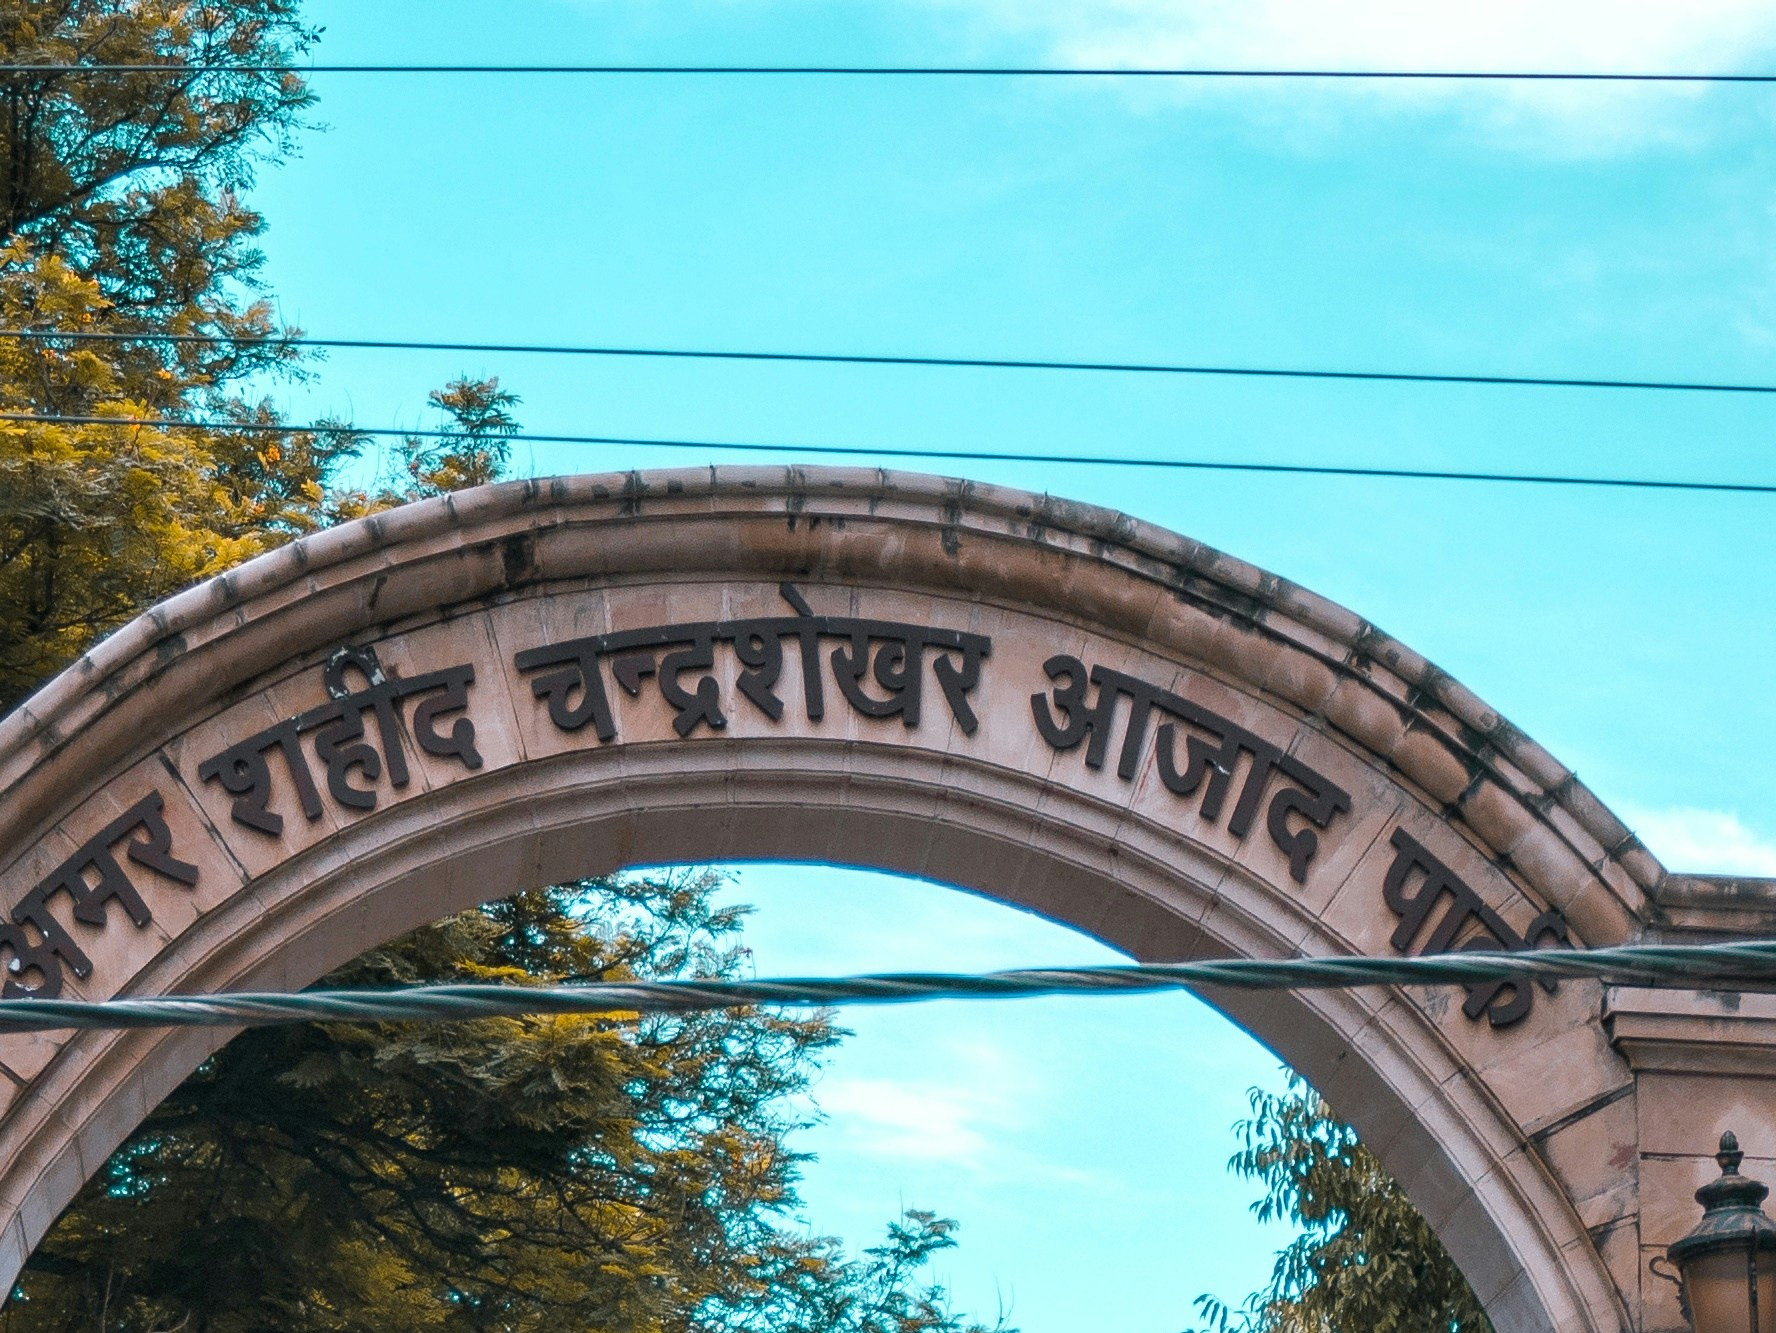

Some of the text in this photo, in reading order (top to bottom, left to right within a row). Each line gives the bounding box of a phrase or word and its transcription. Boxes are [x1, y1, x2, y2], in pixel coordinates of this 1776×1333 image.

[198, 644, 484, 839] शहीद
[514, 581, 993, 743] चन्द्रशेखर
[1029, 653, 1353, 884] आजाद
[1382, 825, 1569, 1030] पार्क
